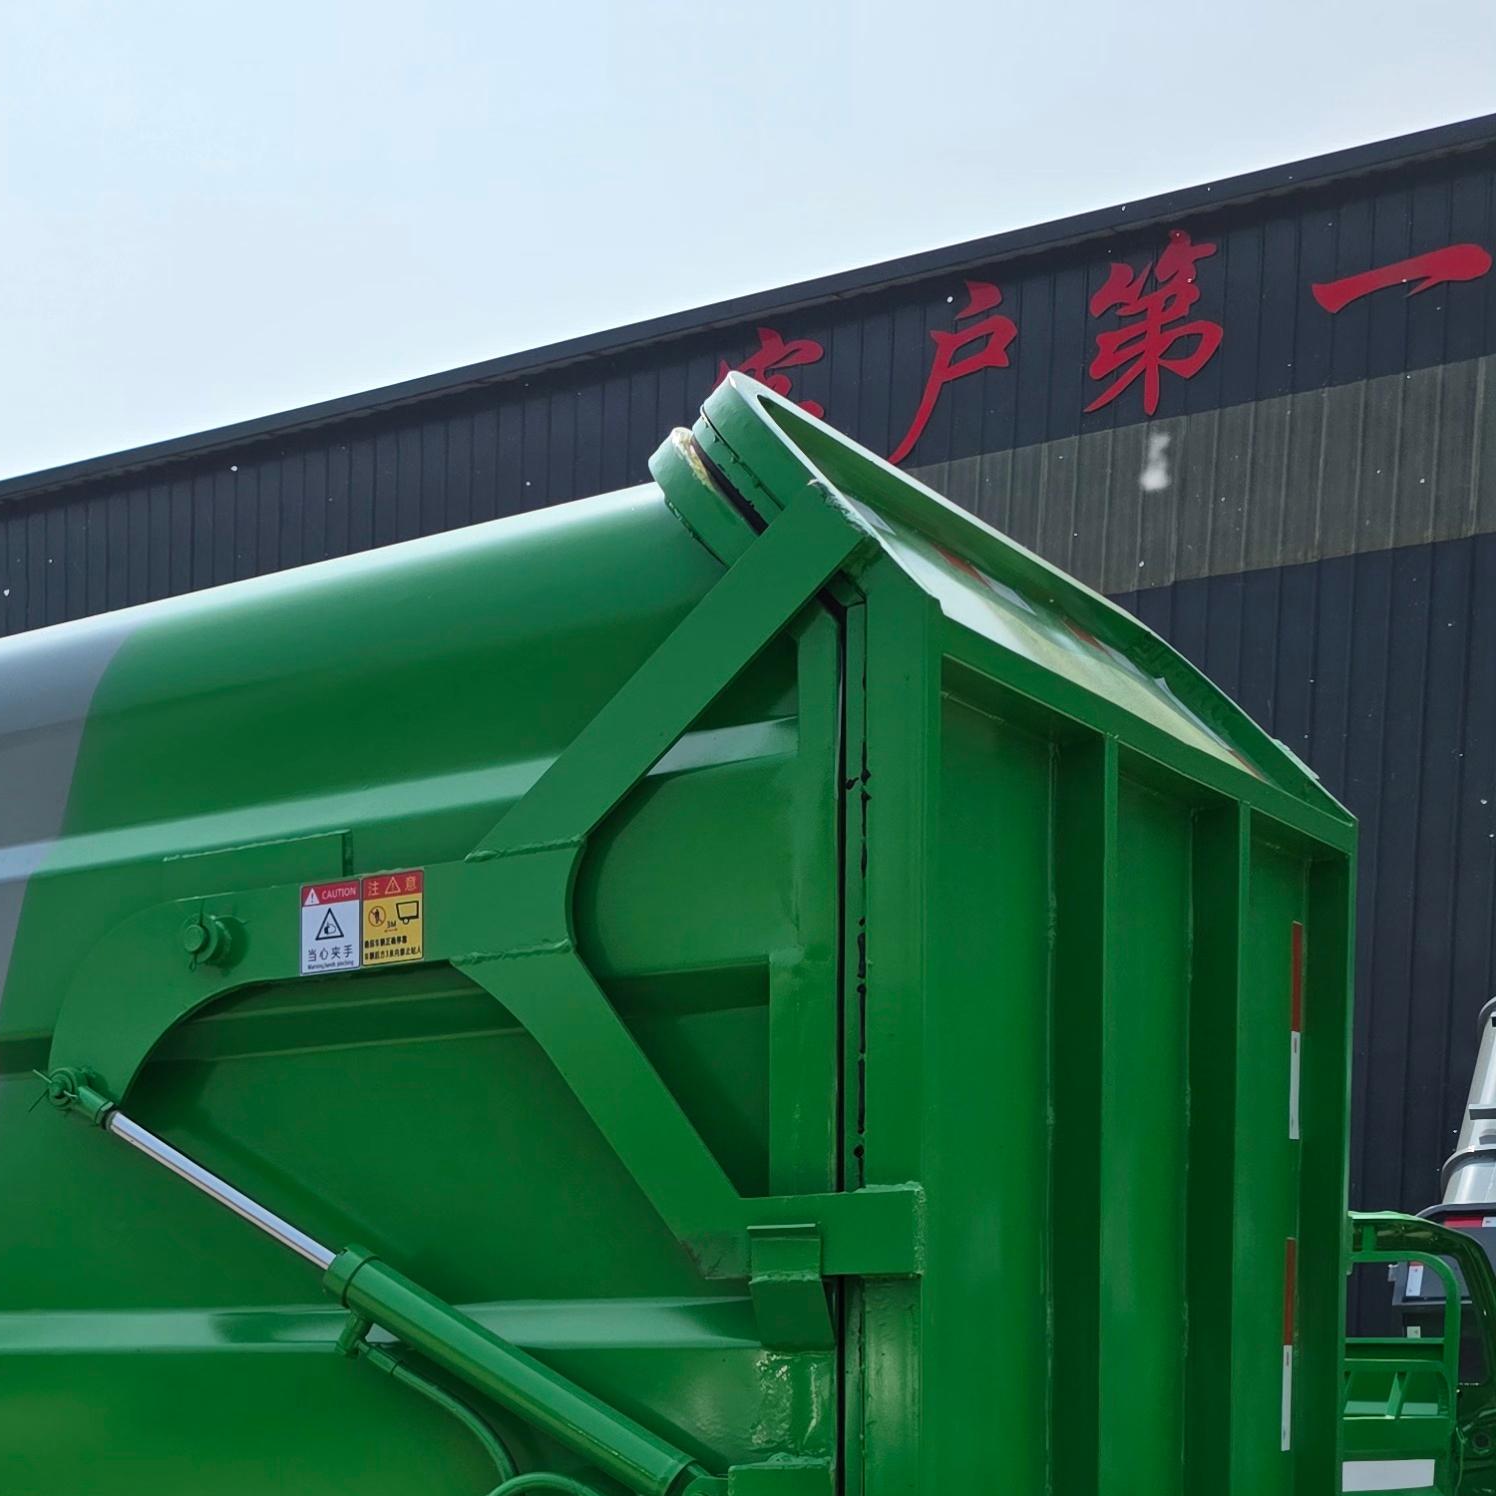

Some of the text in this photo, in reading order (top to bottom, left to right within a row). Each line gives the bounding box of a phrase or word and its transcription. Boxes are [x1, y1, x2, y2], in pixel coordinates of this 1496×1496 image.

[321, 887, 357, 900] CAUTION
[308, 944, 353, 962] 当心夹手
